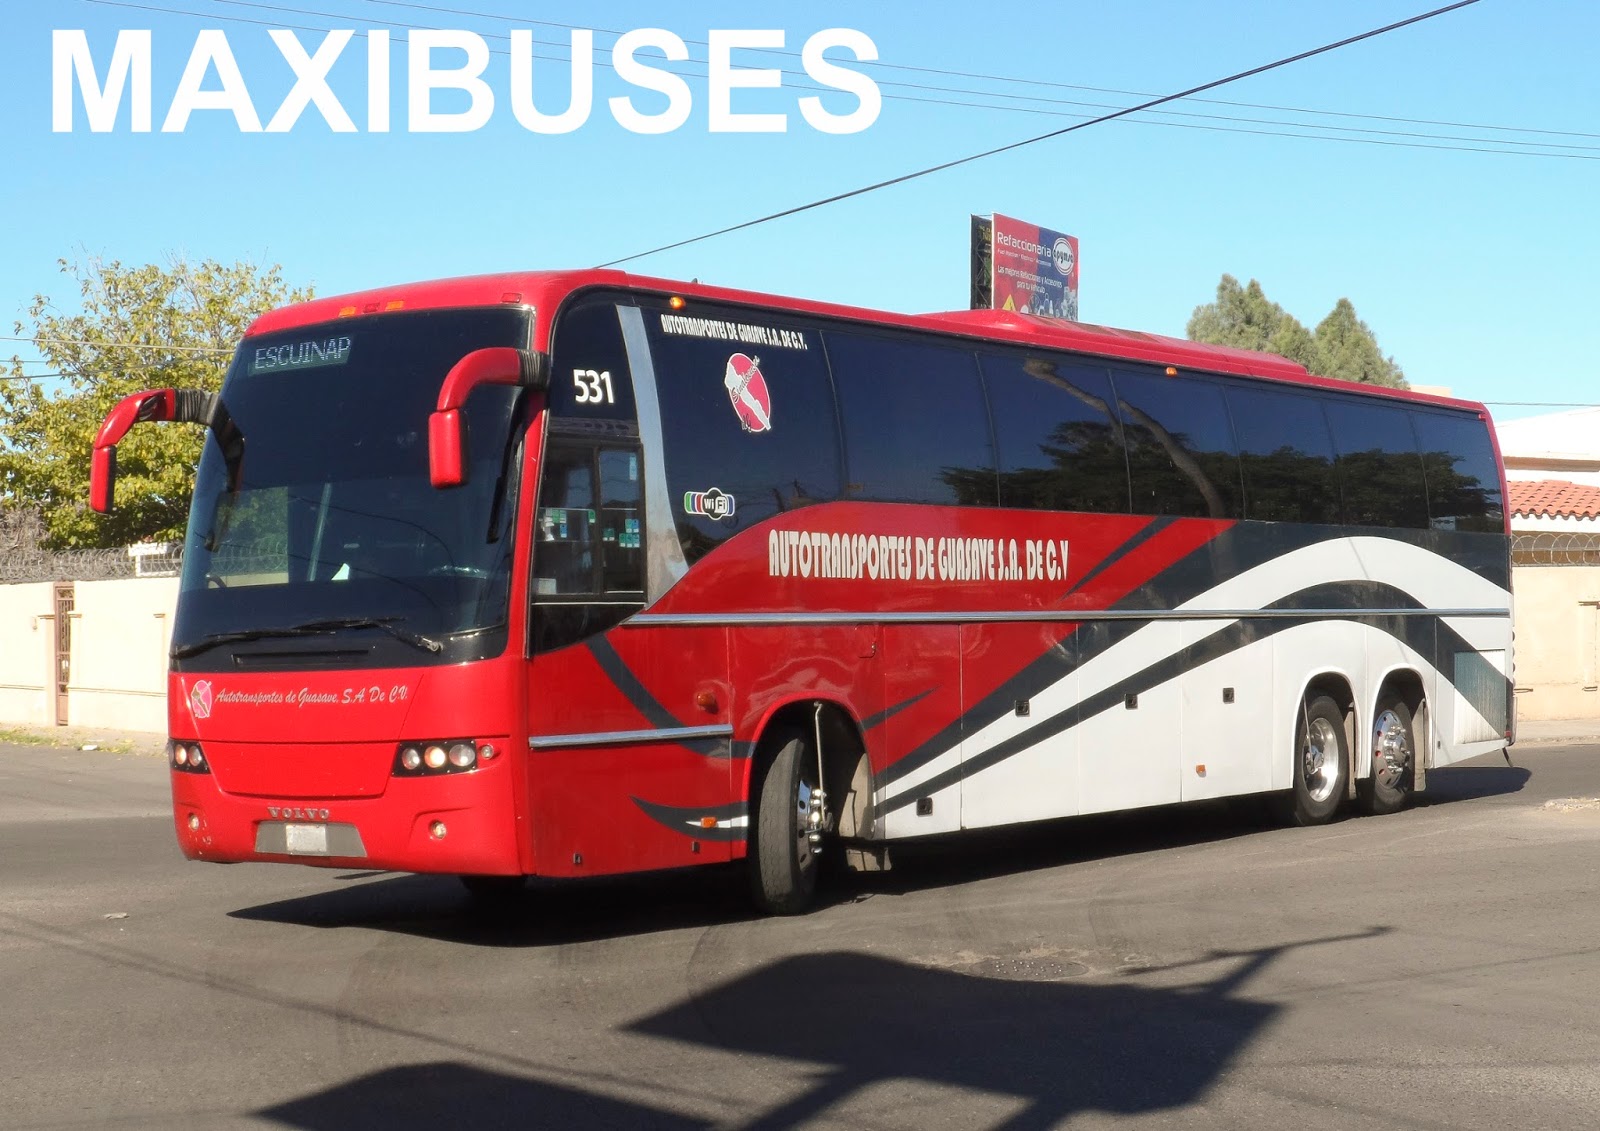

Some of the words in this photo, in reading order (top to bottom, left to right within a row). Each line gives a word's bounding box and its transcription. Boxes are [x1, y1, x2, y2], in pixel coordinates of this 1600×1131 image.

[997, 232, 1052, 257] Refaccionaria
[661, 314, 727, 339] AUTOTRANSPORTES
[726, 322, 738, 340] DE
[738, 324, 767, 344] GUASAVE
[780, 330, 792, 347] DE
[255, 337, 351, 369] ESCUINAP
[573, 369, 614, 404] 531
[768, 529, 911, 580] AUTOTRANSPORTES
[916, 537, 935, 580] DE
[937, 537, 995, 581] GUASAVE
[1026, 539, 1043, 580] DE
[215, 688, 283, 706] Autotransportes
[285, 690, 297, 703] de
[368, 686, 385, 702] De
[267, 807, 330, 820] VOLVO
